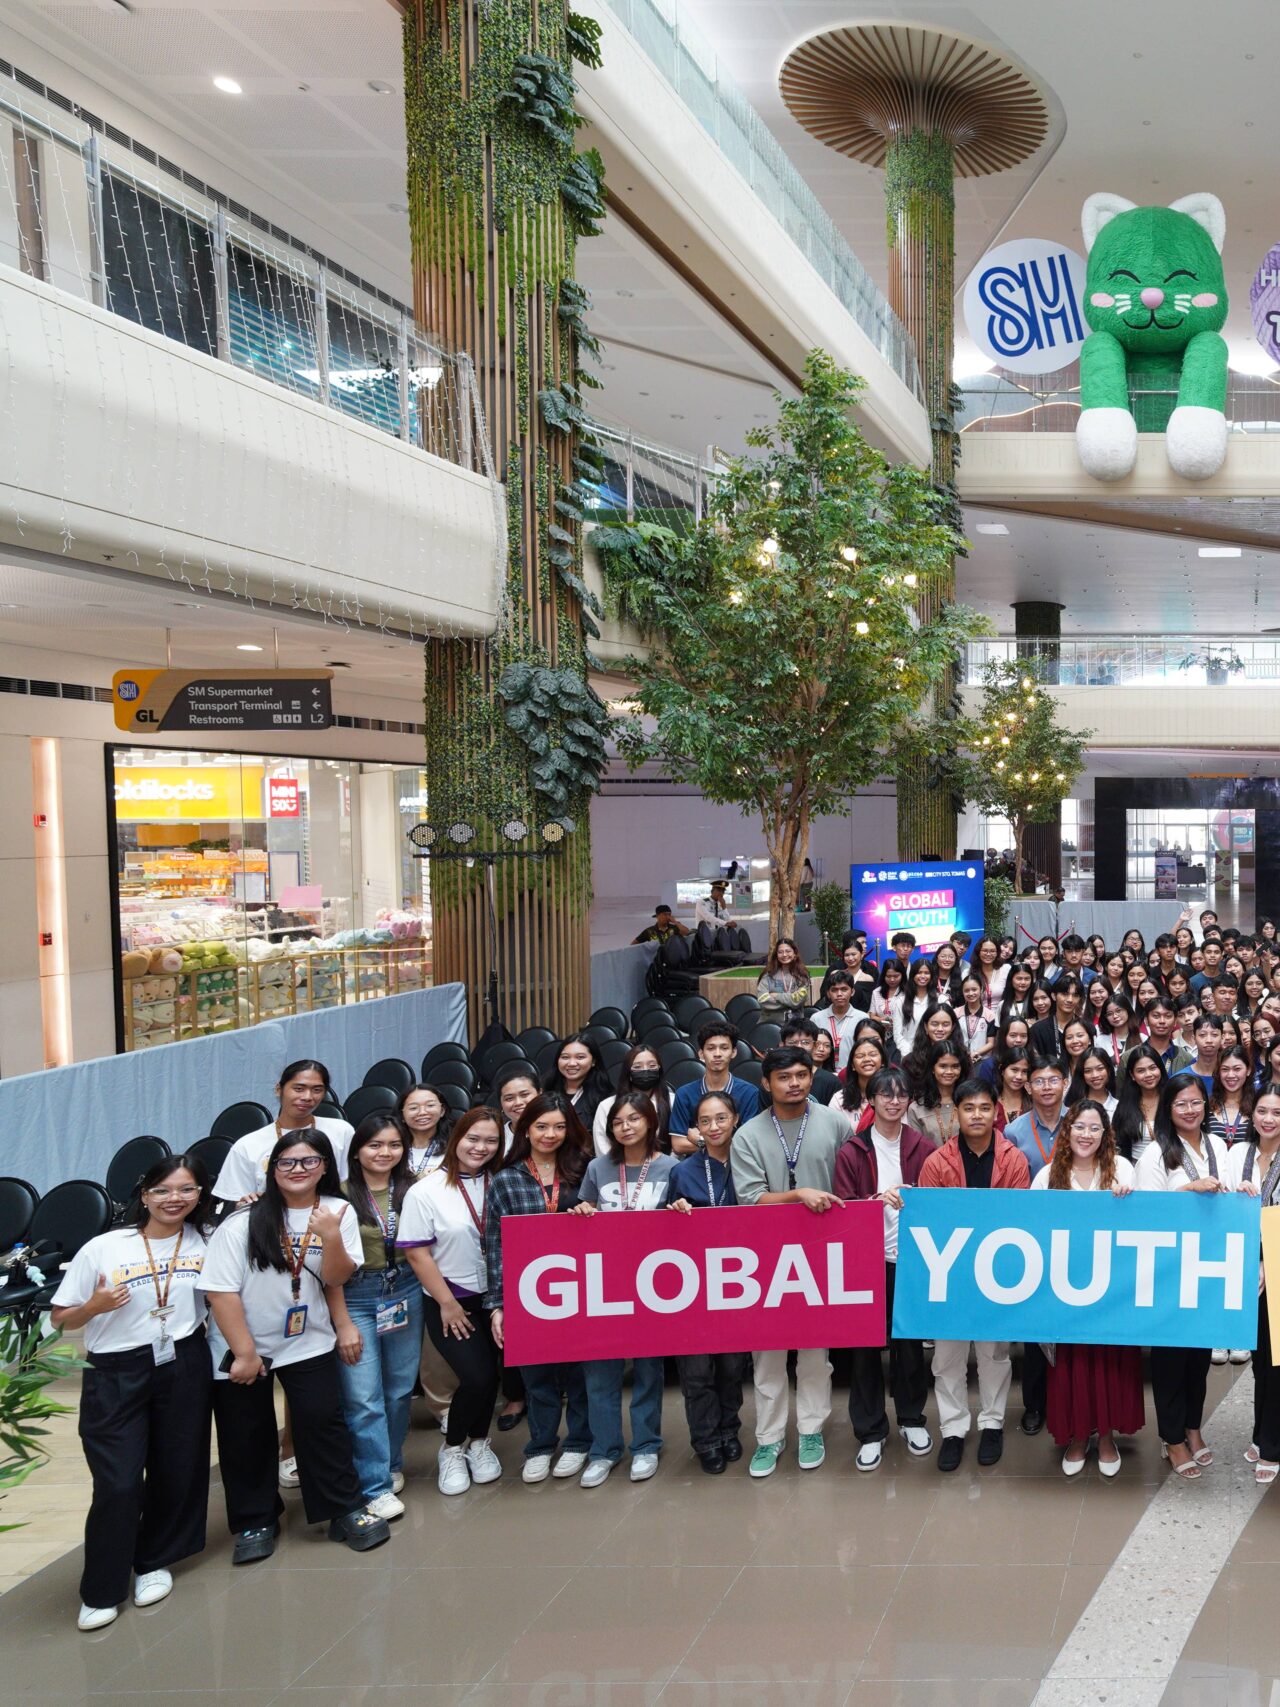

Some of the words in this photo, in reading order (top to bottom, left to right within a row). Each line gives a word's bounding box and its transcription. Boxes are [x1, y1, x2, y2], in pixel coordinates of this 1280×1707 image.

[978, 253, 1085, 357] SM
[188, 687, 205, 696] SM
[208, 687, 273, 698] Supermarket
[190, 701, 237, 712] Transport
[240, 701, 282, 710] Terminal
[136, 709, 159, 723] GL
[189, 715, 244, 724] Restrooms
[311, 714, 324, 723] L2
[271, 786, 296, 797] MINI
[889, 893, 948, 909] GLOBAL
[897, 911, 948, 926] YOUTH
[387, 1211, 396, 1239] AKSYON
[908, 1226, 1246, 1310] YOUTH
[517, 1241, 874, 1320] GLOBAL
